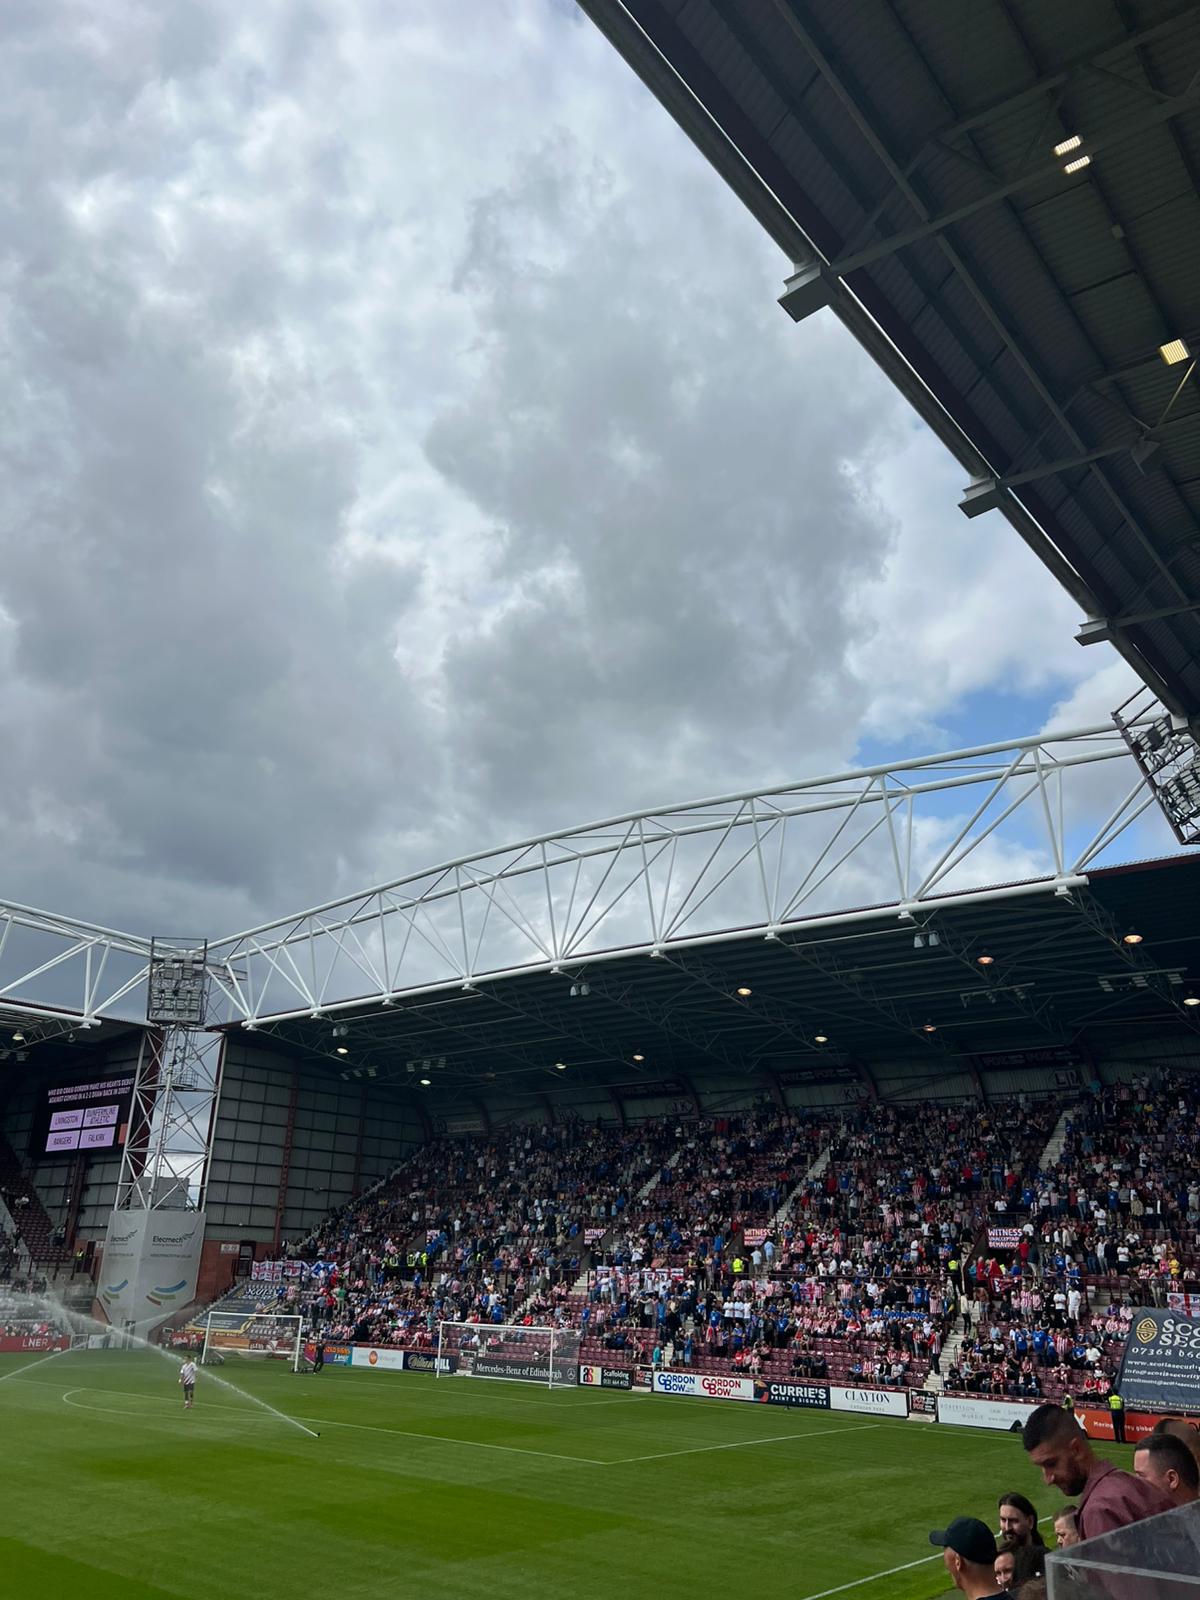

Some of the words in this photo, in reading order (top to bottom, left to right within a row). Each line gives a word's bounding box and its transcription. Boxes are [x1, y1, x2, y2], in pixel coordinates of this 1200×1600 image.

[744, 1228, 773, 1236] WITNESS
[988, 1228, 1023, 1236] WITNESS
[22, 1337, 48, 1348] LNER
[1131, 1347, 1172, 1356] 07368
[434, 1358, 451, 1370] HILL
[476, 1363, 520, 1375] Mercedes-Benz
[522, 1367, 530, 1376] of
[529, 1367, 562, 1379] Edinburgh
[603, 1369, 630, 1380] Scaffolding
[658, 1374, 695, 1385] GORDON
[664, 1379, 686, 1392] BOW
[702, 1377, 741, 1389] GORDON
[708, 1384, 731, 1396] BOW
[770, 1384, 827, 1399] CURRIE'S
[845, 1390, 890, 1403] CLAYTON
